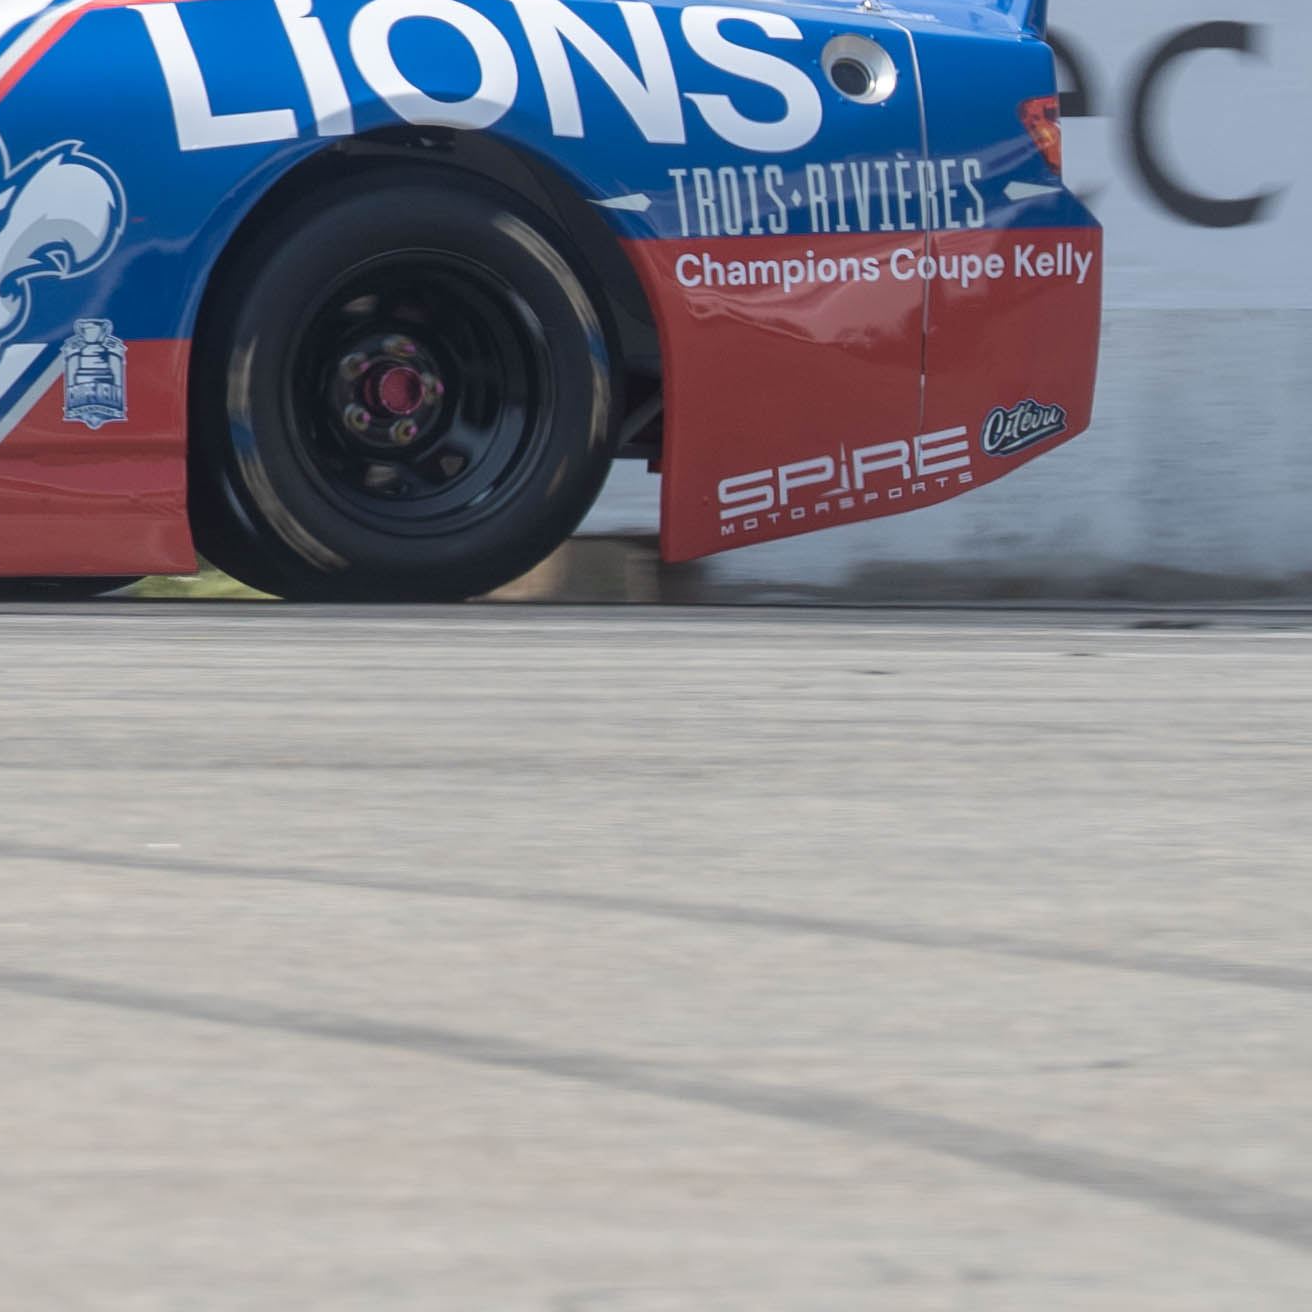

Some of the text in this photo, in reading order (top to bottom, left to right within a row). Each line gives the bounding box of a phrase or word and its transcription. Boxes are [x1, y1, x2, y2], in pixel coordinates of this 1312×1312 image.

[676, 243, 1094, 292] Champions Coupe Kelly
[718, 425, 971, 520] SPIRE
[720, 472, 973, 536] MOTORSPORTS
